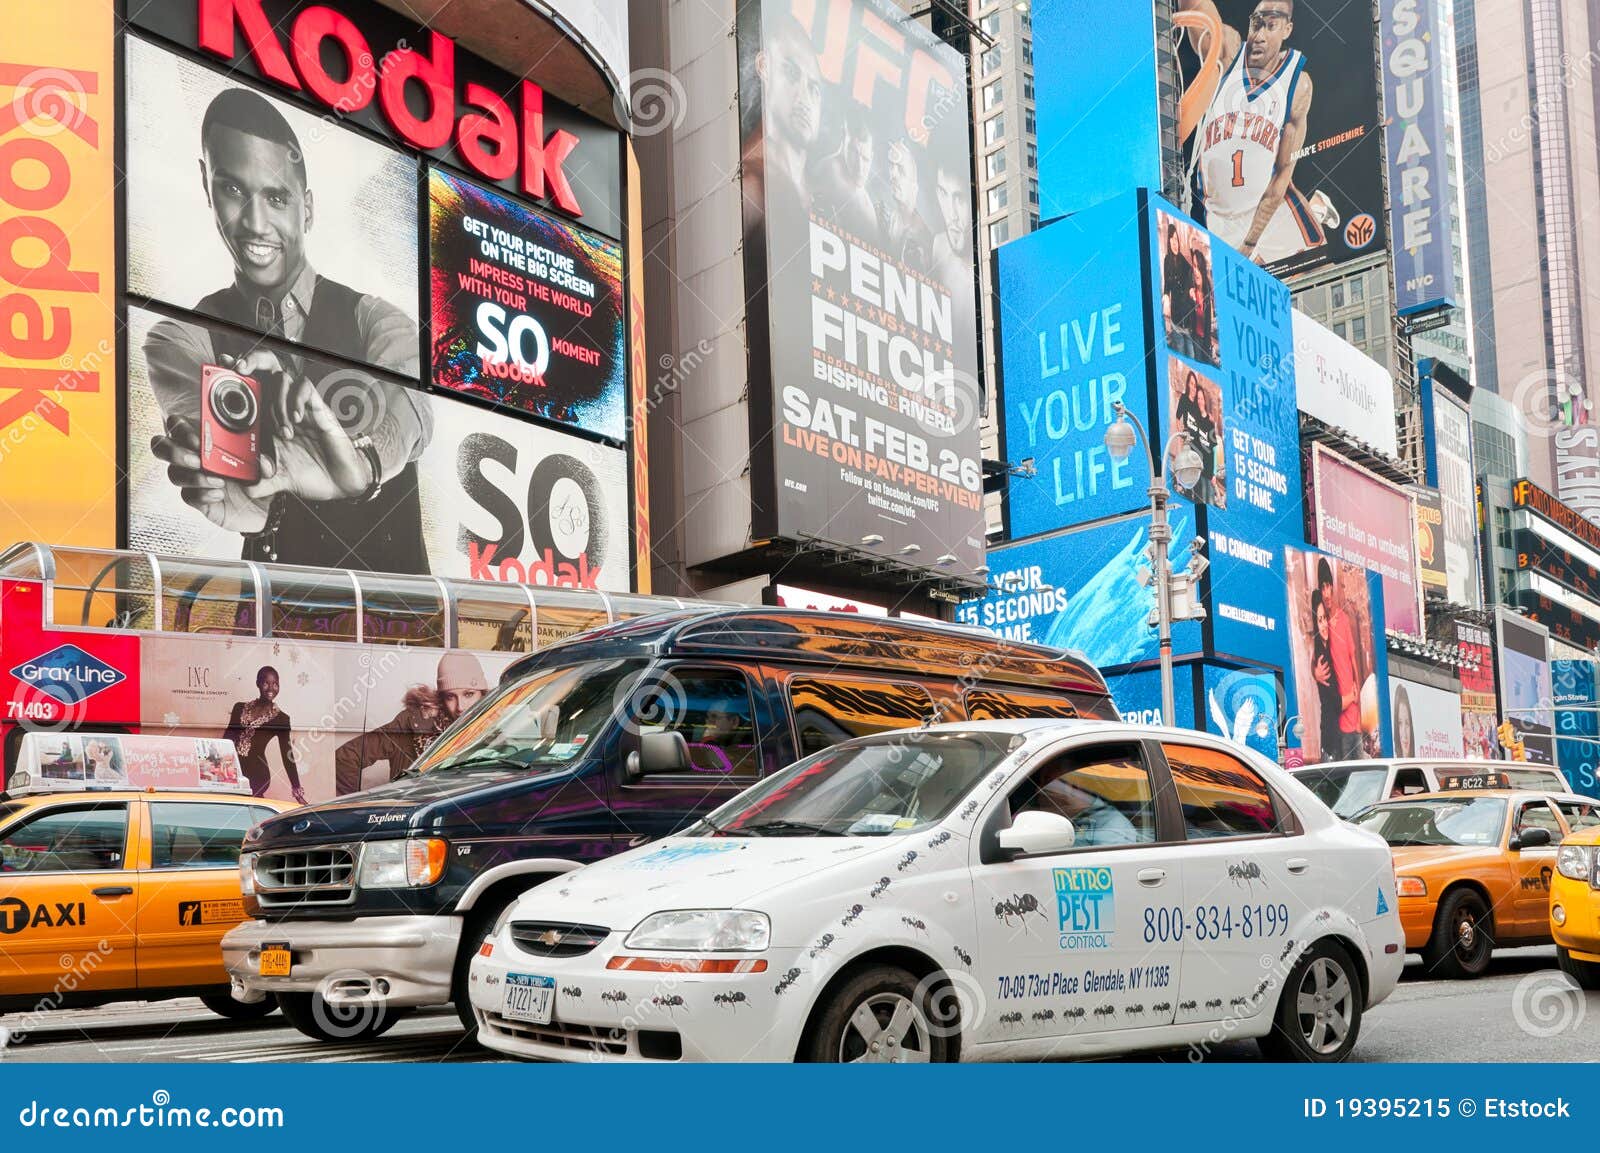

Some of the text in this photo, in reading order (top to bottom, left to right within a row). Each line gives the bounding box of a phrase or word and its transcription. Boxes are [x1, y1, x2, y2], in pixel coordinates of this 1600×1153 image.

[791, 0, 955, 148] UFC
[1204, 111, 1281, 153] NEW YORK
[1317, 125, 1366, 151] STOUDEMIRE
[1388, 0, 1433, 251] SQUARE
[1231, 149, 1245, 188] 1
[0, 62, 100, 438] Kodak
[463, 215, 574, 275] GET YOUR PICTURE
[470, 258, 593, 318] IMPRESS THE WORLD
[480, 240, 595, 299] ON THE BIG SCREEN
[808, 221, 953, 345] PENN
[1406, 274, 1434, 292] NYC
[457, 272, 527, 313] WITH YOUR
[1224, 255, 1280, 329] LEAVE
[475, 301, 550, 376] SO
[877, 310, 898, 333] VS
[1038, 303, 1125, 380] LIVE
[481, 352, 547, 388] Kodak
[551, 335, 601, 367] MOMENT
[811, 294, 956, 409] FITCH
[1232, 315, 1282, 386] YOUR
[782, 385, 860, 448] SAT.
[812, 359, 889, 408] BISPING
[899, 396, 957, 436] RIVERA
[1018, 372, 1127, 448] YOUR
[1230, 369, 1286, 434] MARK
[783, 423, 982, 511] LIVE ON PAY-PER-VIEW
[1232, 429, 1276, 467] GET YOUR
[840, 468, 939, 513] Follow us on facebook.com/UFC
[1053, 445, 1133, 506] LIFE
[1234, 453, 1288, 496] 15 SECONDS
[1235, 477, 1276, 513] OF FAME.
[456, 432, 609, 577] SO
[867, 492, 916, 519] twitter.com/ufc
[1347, 520, 1366, 545] than
[1367, 532, 1377, 550] an
[467, 540, 602, 591] Kodak
[993, 565, 1043, 596] YOUR
[958, 606, 979, 627] 15
[983, 586, 1068, 626] SECONDS
[988, 622, 1039, 645] AME.
[21, 664, 116, 683] Gray Line
[6, 701, 54, 720] 71403
[1462, 777, 1484, 789] 6C22
[367, 812, 407, 826] Explorer
[1053, 868, 1112, 891] METRO
[0, 902, 86, 930] TAXI
[1057, 893, 1103, 932] PEST
[1143, 903, 1289, 944] 800-834-8199
[1059, 934, 1108, 949] CONTROL
[998, 965, 1170, 1000] 70-09 73rd Place Glendale, NY 11385
